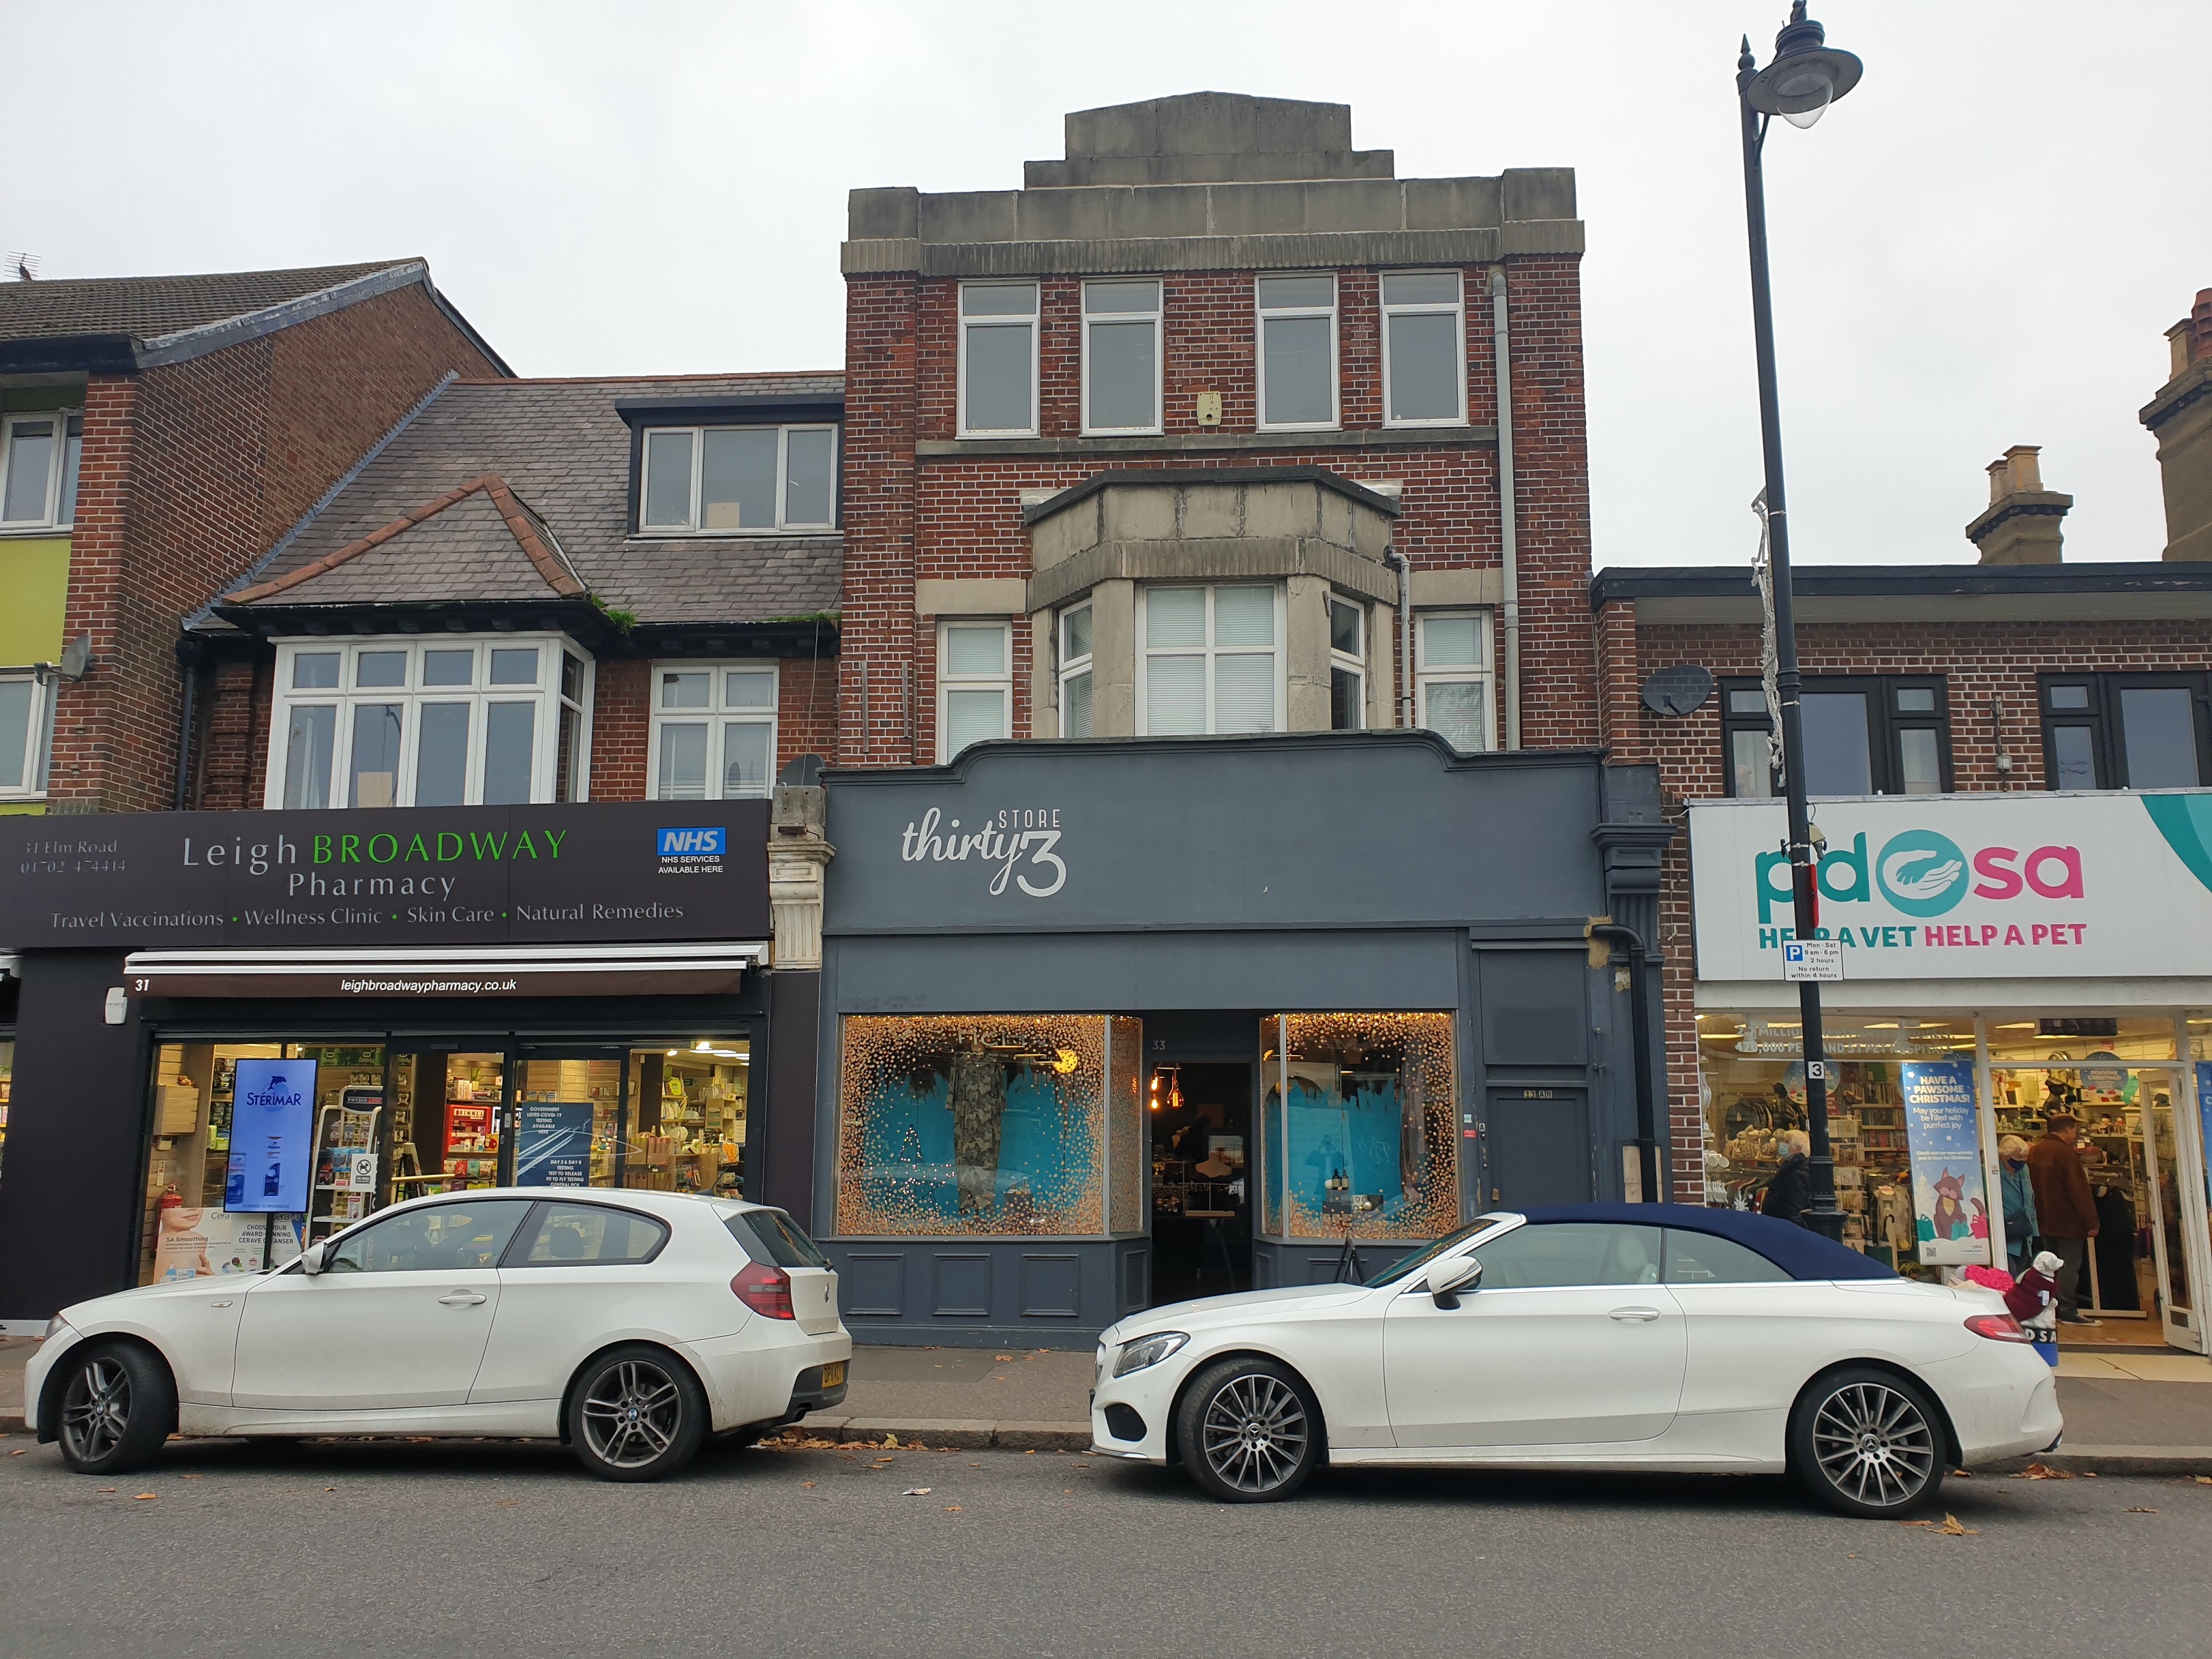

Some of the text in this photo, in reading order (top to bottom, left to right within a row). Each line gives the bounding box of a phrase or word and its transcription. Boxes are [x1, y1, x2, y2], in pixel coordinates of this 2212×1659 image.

[998, 809, 1060, 829] STORE
[664, 830, 719, 852] NHS
[44, 841, 72, 854] Elm
[78, 840, 117, 853] Road
[183, 830, 567, 875] Leigh BROADWAY
[680, 855, 720, 863] SERVICES
[658, 866, 700, 874] AVAILABLE
[288, 872, 456, 901] Pharmacy
[51, 902, 684, 928] Travel Vaccinations Wellness Clinic Skin Care Natural Remedies
[1759, 928, 1830, 948] HEP
[1860, 926, 1917, 947] VET
[1924, 925, 1998, 947] HELP
[2004, 924, 2026, 946] A
[2031, 923, 2087, 945] PET
[135, 978, 517, 994] 31 leighbroadwaypharmacy.co.uk
[1759, 1027, 1801, 1037] MILLIO
[1152, 1040, 1166, 1051] 33
[1891, 1043, 1954, 1054] HSPITALS
[1812, 1063, 1822, 1077] 3
[1920, 1076, 1958, 1085] HAVE A
[1913, 1085, 1965, 1094] PAWSOME
[1909, 1094, 1971, 1104] CHRISTMAS!
[1913, 1107, 1969, 1116] May your holiday
[1951, 1121, 1962, 1130] joy
